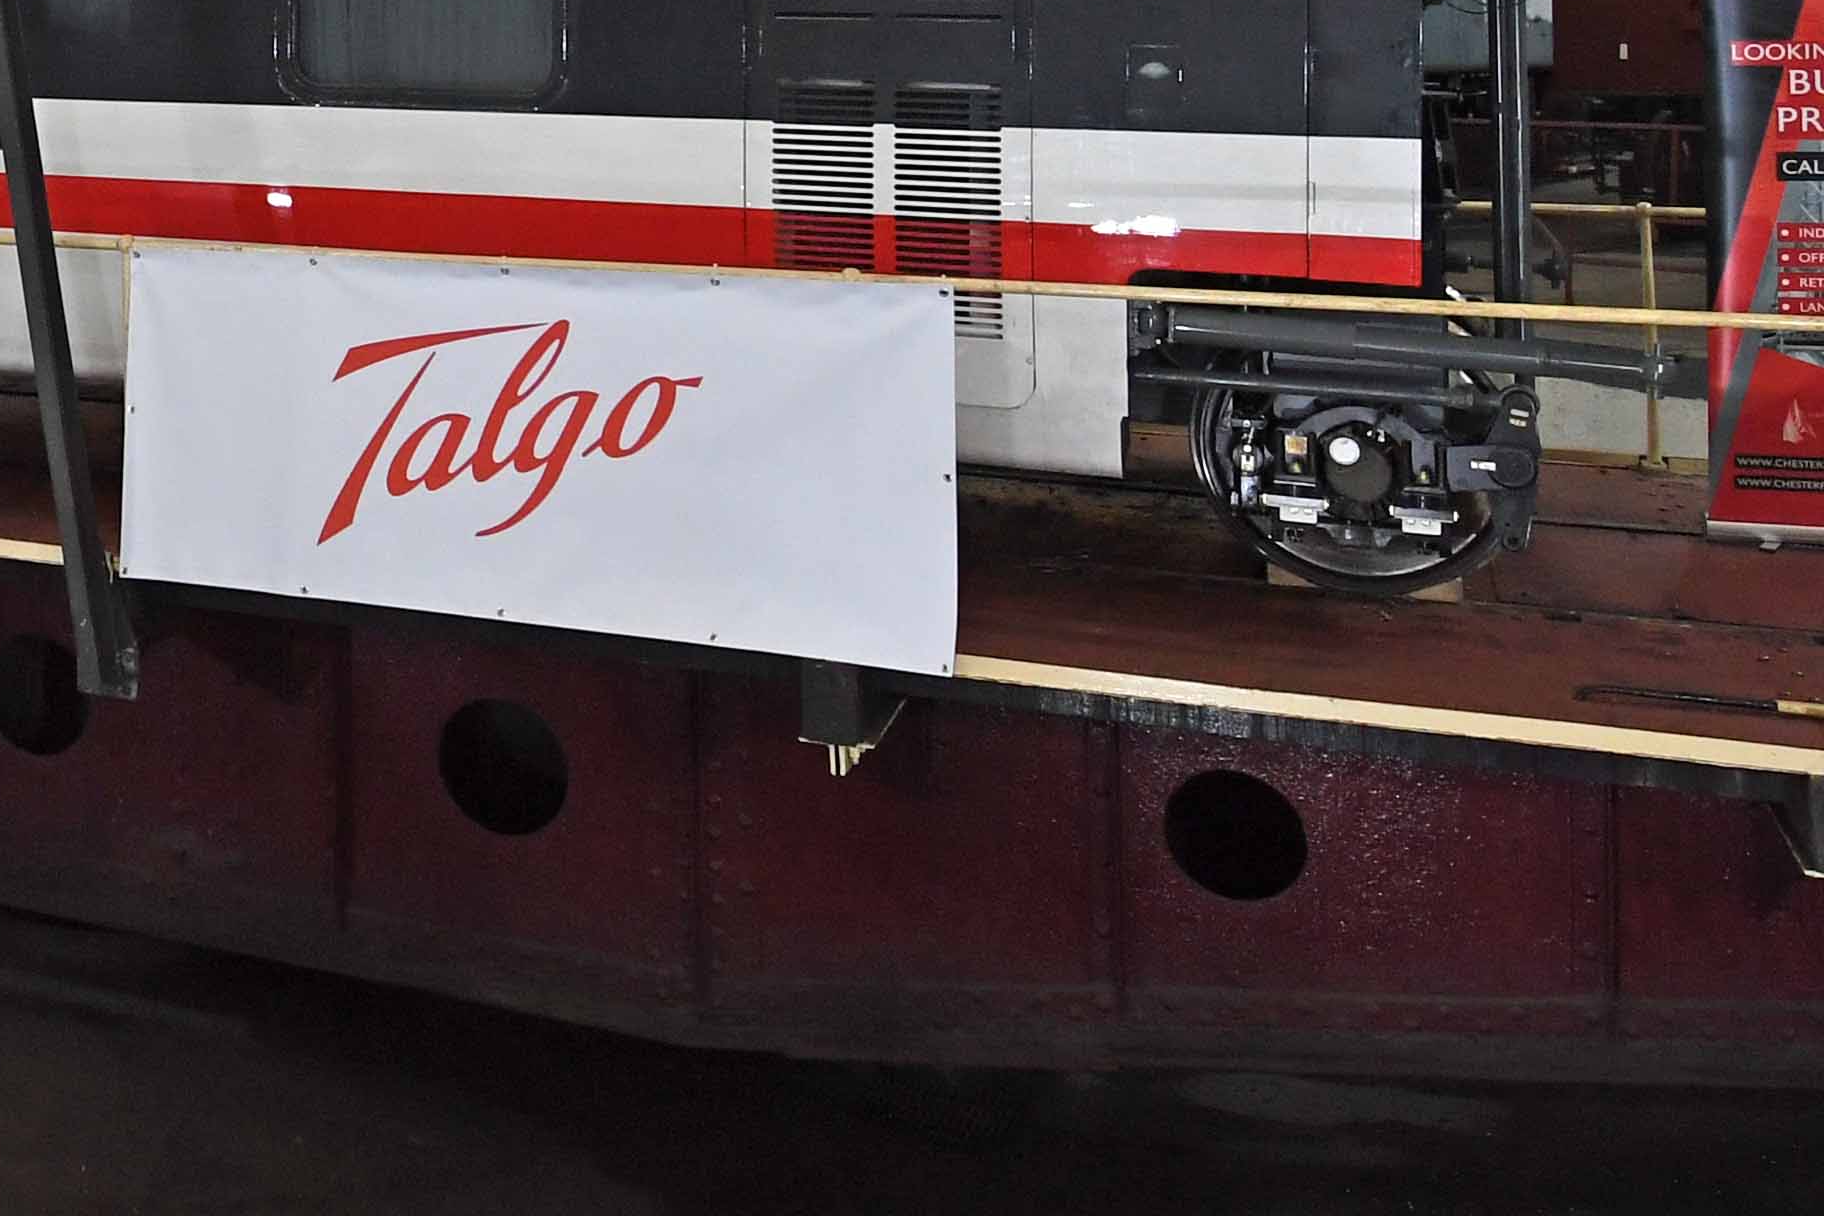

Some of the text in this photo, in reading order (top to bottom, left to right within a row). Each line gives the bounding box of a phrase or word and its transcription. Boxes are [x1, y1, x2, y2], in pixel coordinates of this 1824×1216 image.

[1777, 106, 1824, 132] PR
[1782, 159, 1824, 175] CAL
[316, 319, 703, 546] Talgo
